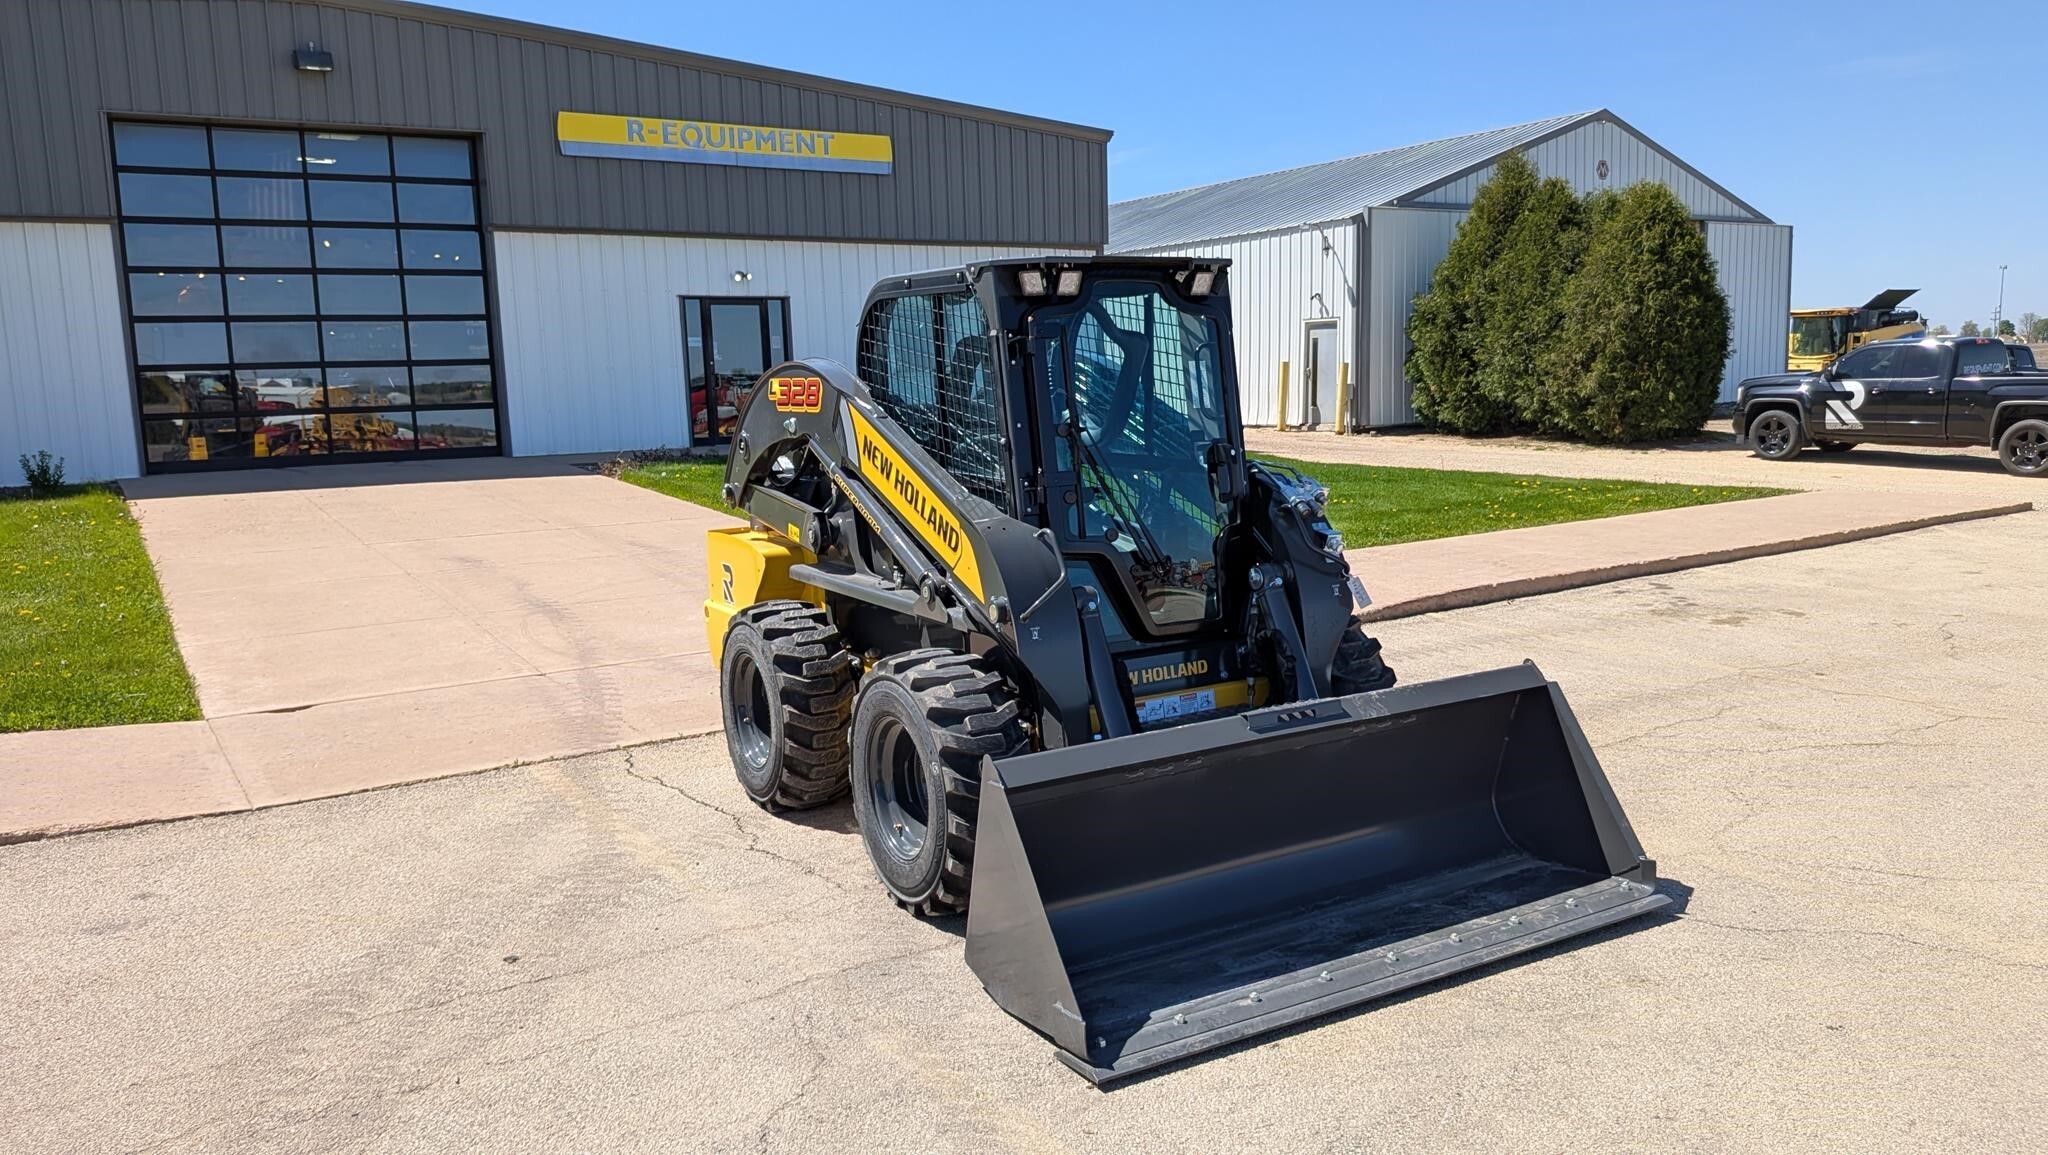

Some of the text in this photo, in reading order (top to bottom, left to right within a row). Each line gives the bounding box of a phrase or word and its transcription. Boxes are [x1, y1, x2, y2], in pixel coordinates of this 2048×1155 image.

[627, 119, 834, 155] R-EQUIPMENT
[768, 378, 822, 412] L328
[862, 434, 960, 553] NEW HOLLAND
[1142, 660, 1208, 683] HOLLAND
